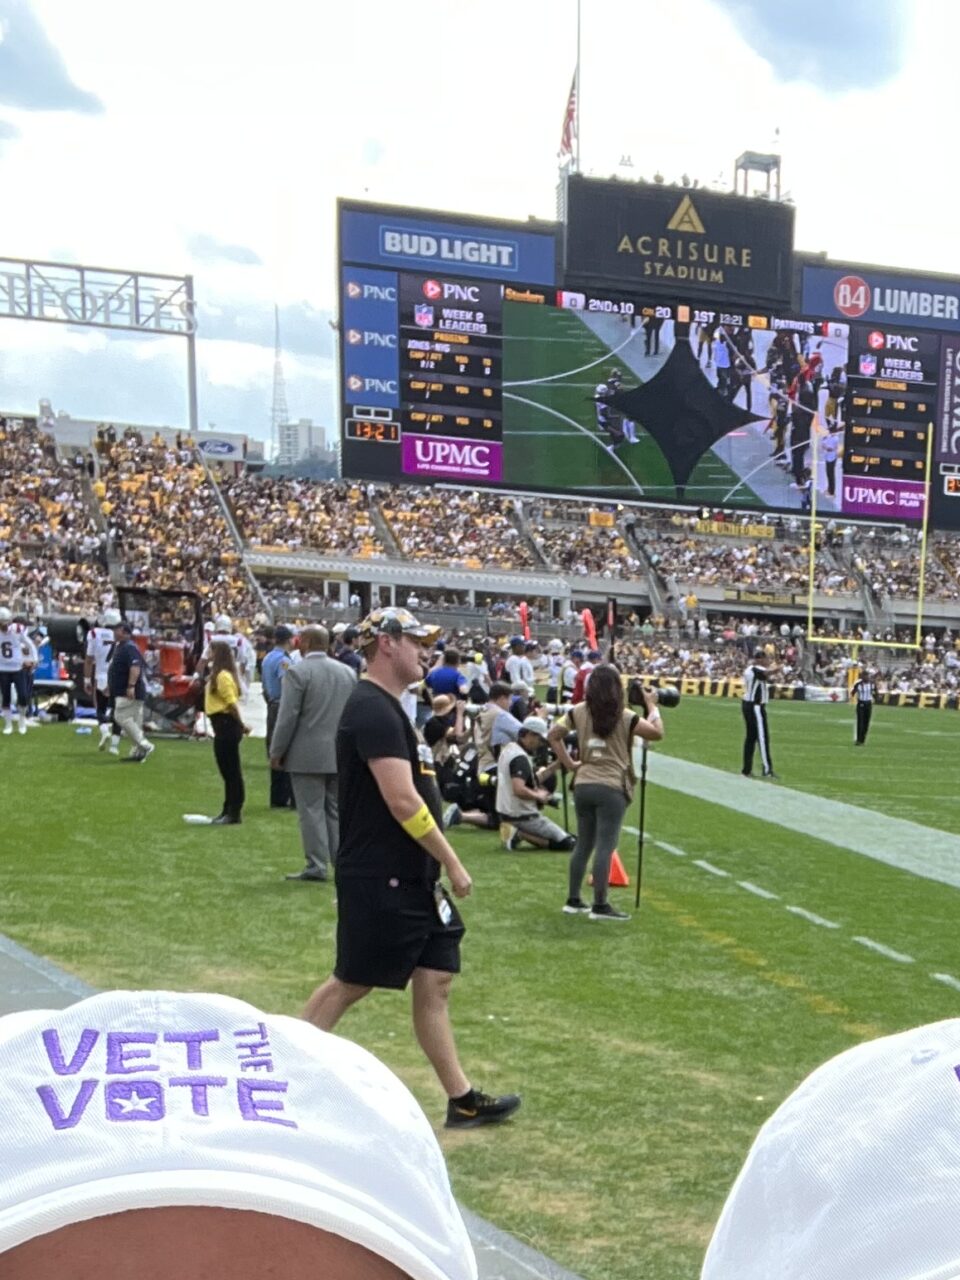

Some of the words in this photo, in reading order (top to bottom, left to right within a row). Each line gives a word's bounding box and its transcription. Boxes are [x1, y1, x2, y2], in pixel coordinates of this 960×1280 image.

[384, 231, 438, 257] BUD
[440, 238, 514, 266] LIGHT
[616, 233, 752, 268] ACRISURE
[643, 260, 725, 284] STADIUM
[363, 284, 397, 301] PNC
[442, 282, 480, 302] PNC
[837, 283, 867, 310] 84
[872, 287, 960, 320] LUMBER
[441, 308, 474, 321] WEEK
[475, 311, 485, 323] 2
[693, 310, 716, 323] 1ST
[438, 319, 488, 334] LEADERS
[363, 331, 397, 348] PNC
[885, 334, 919, 352] PNC
[880, 367, 924, 381] LEADERS
[884, 357, 912, 370] WEEK
[913, 360, 922, 371] 2
[364, 378, 398, 394] PNC
[415, 440, 490, 468] UPMC
[844, 486, 896, 506] UPMC
[41, 1027, 220, 1076] VET
[232, 1021, 275, 1073] THE
[35, 1074, 299, 1131] VOTE
